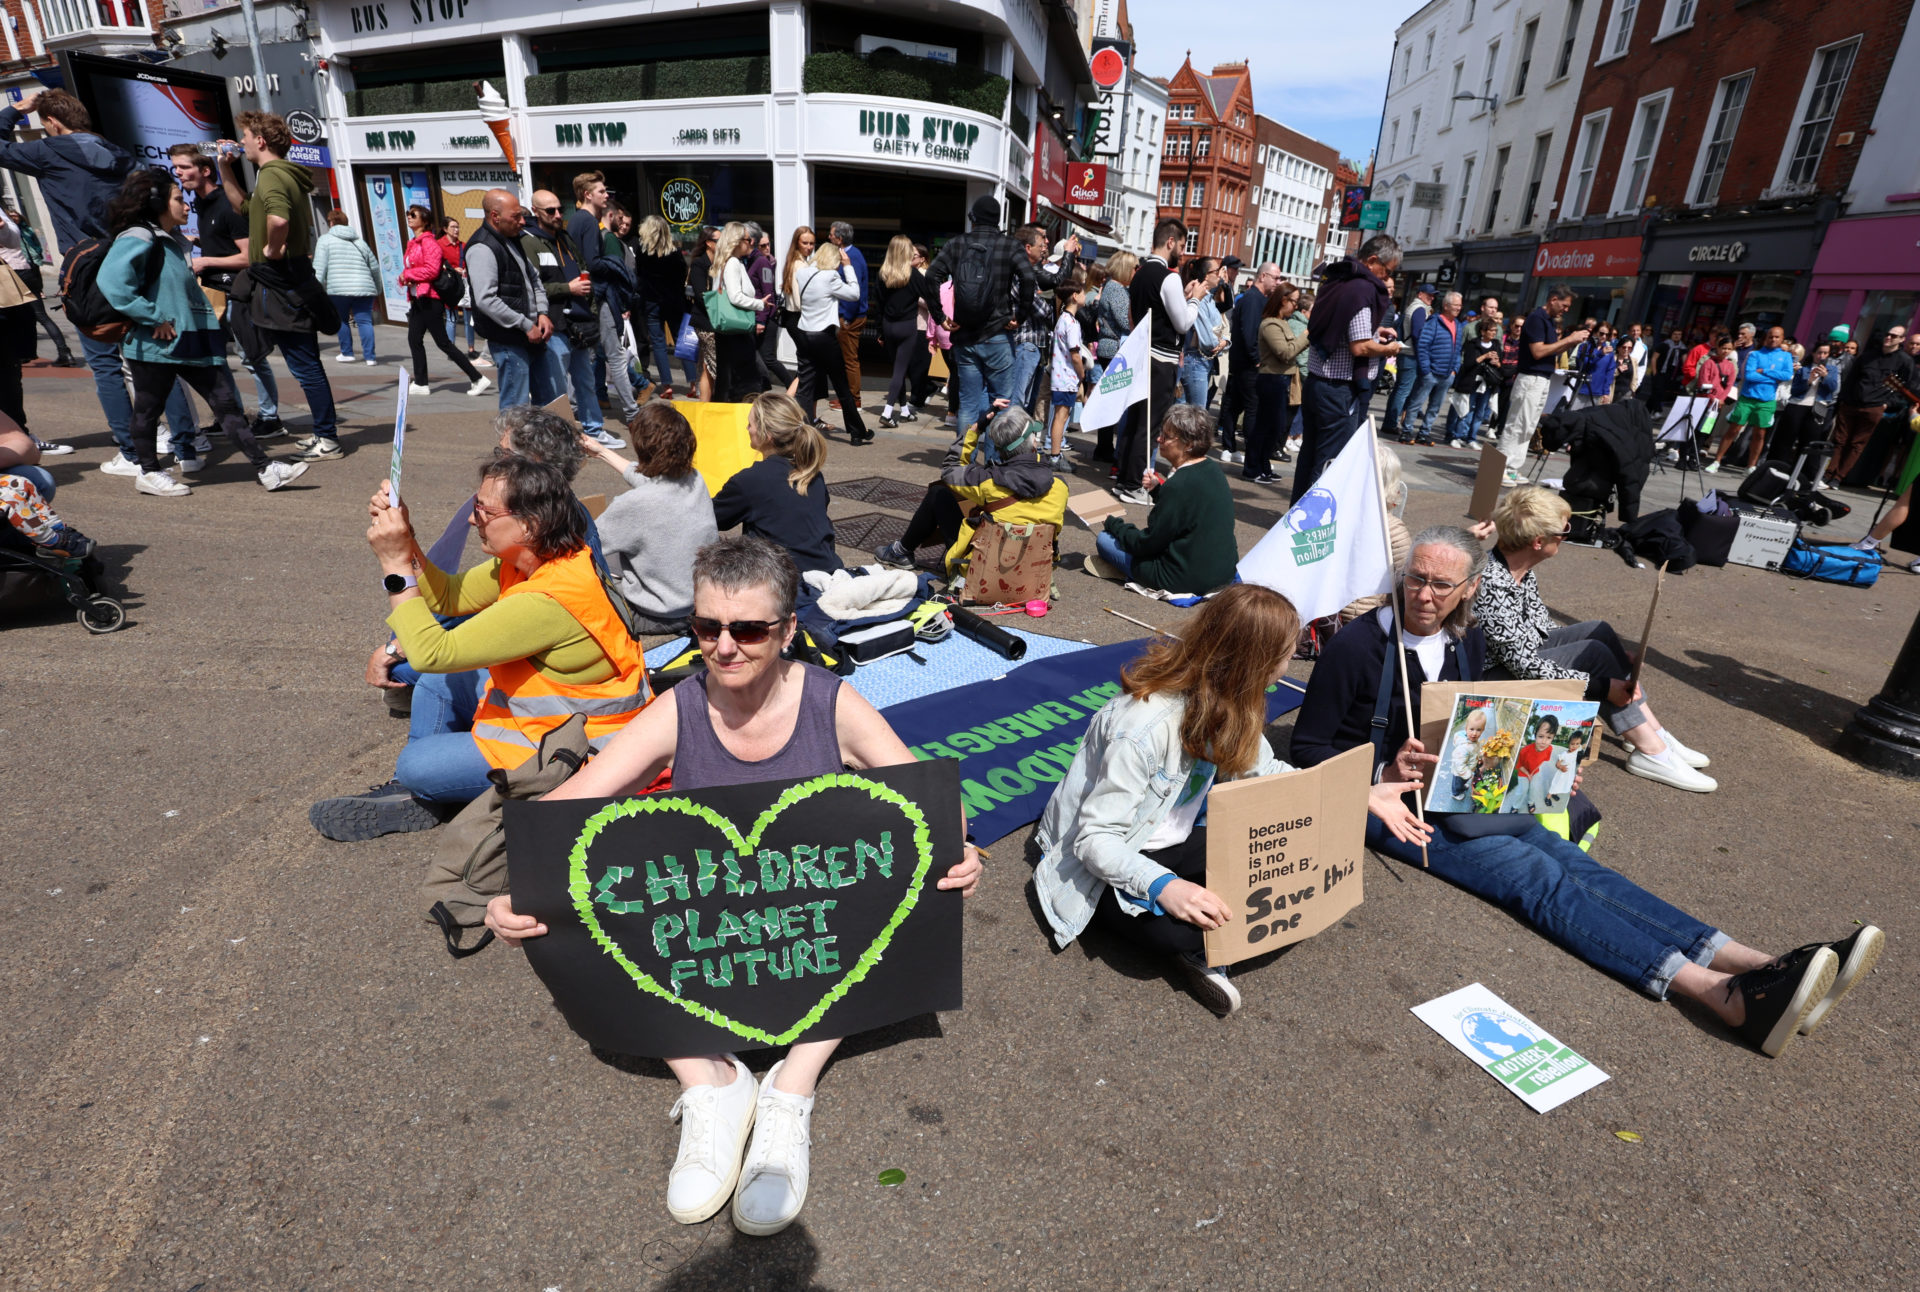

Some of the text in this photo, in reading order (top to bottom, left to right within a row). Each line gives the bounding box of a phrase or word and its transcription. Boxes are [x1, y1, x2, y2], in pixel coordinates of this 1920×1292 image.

[351, 0, 469, 33] BUS STOP
[1094, 85, 1115, 147] stax
[555, 122, 627, 143] BUS STOP
[679, 128, 741, 142] CARDS GIFTS
[860, 110, 979, 147] BUS STOP
[287, 151, 321, 162] ARBER
[289, 145, 320, 155] RAFTON
[873, 138, 970, 160] GAIETY CORNER
[443, 171, 456, 181] ICE
[459, 171, 487, 181] CREAM
[663, 182, 701, 202] BARISTA
[1071, 184, 1099, 198] Gino's
[668, 196, 699, 221] Coffee
[1547, 250, 1595, 269] vodafone
[1689, 245, 1729, 262] CIRCLE
[1440, 268, 1451, 280] 3
[1249, 816, 1313, 840] because
[1249, 837, 1288, 855] there
[594, 831, 894, 914] CHILDREN
[1249, 852, 1285, 870] is no
[1249, 862, 1295, 887] planet
[1245, 858, 1354, 925] Save this
[652, 899, 837, 958] PLANET
[1247, 912, 1302, 944] one
[670, 936, 841, 996] FUTURE
[1494, 1045, 1549, 1077] MOTHERS
[1528, 1054, 1584, 1087] rebellion
